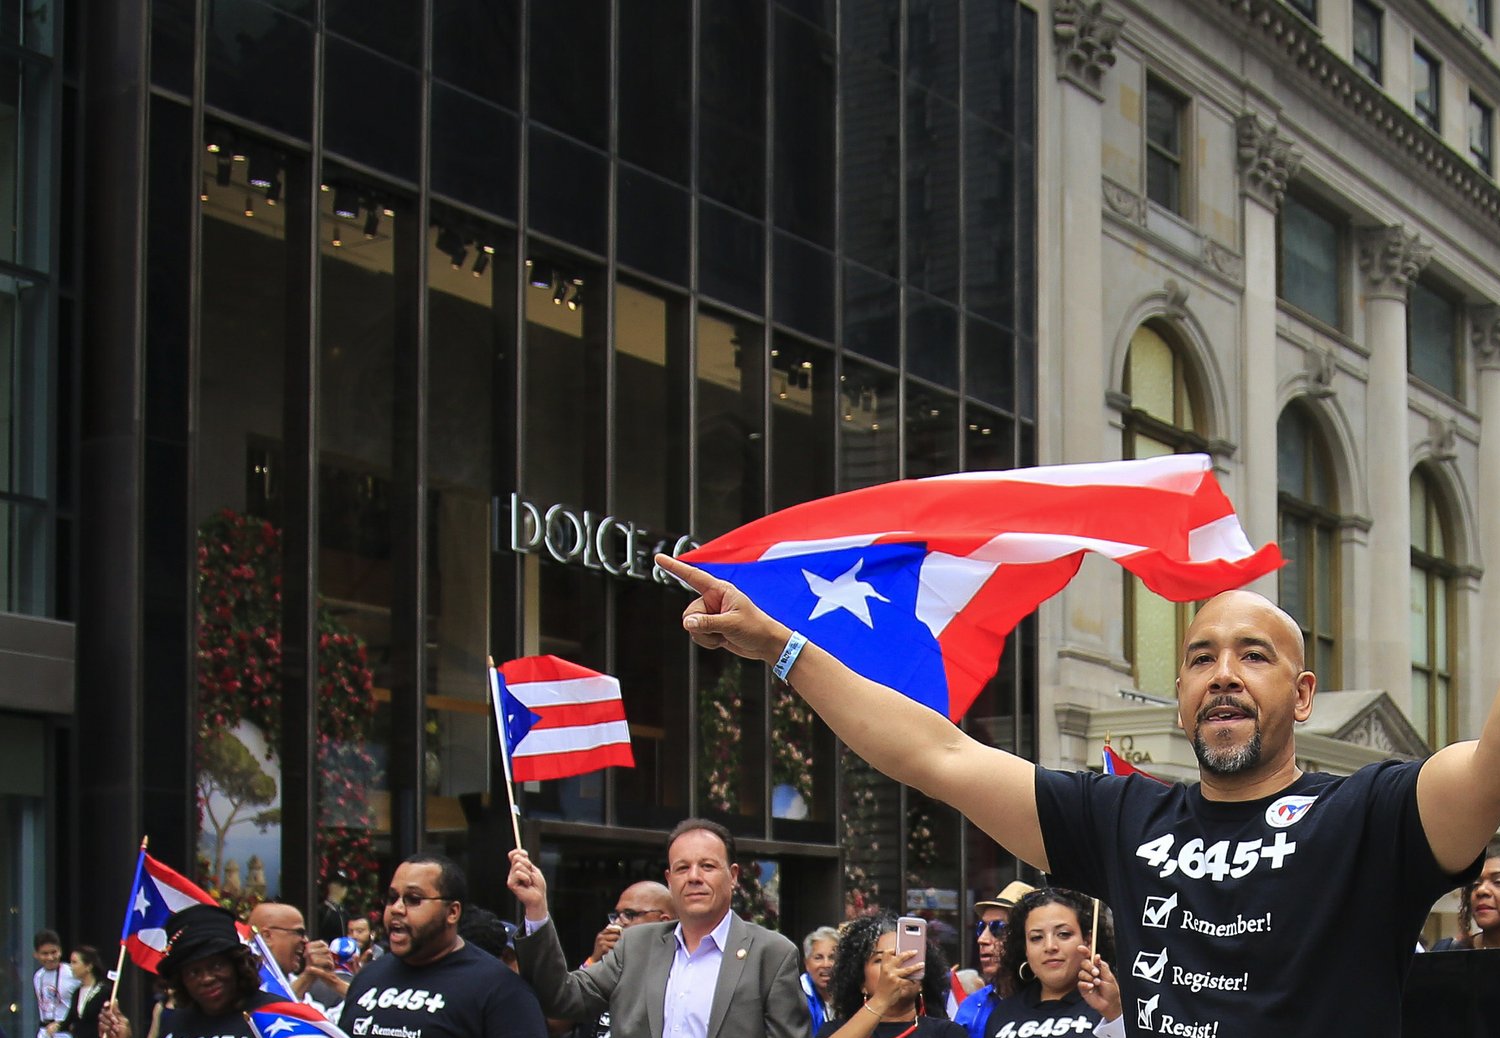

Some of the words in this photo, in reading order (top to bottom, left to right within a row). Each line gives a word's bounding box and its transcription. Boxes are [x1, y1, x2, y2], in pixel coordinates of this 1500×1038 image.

[1136, 832, 1297, 881] 4,645+
[1180, 910, 1272, 937] Remember!
[1172, 966, 1249, 992] Register!
[357, 988, 446, 1013] 4,645+
[1159, 1015, 1219, 1038] Resist!
